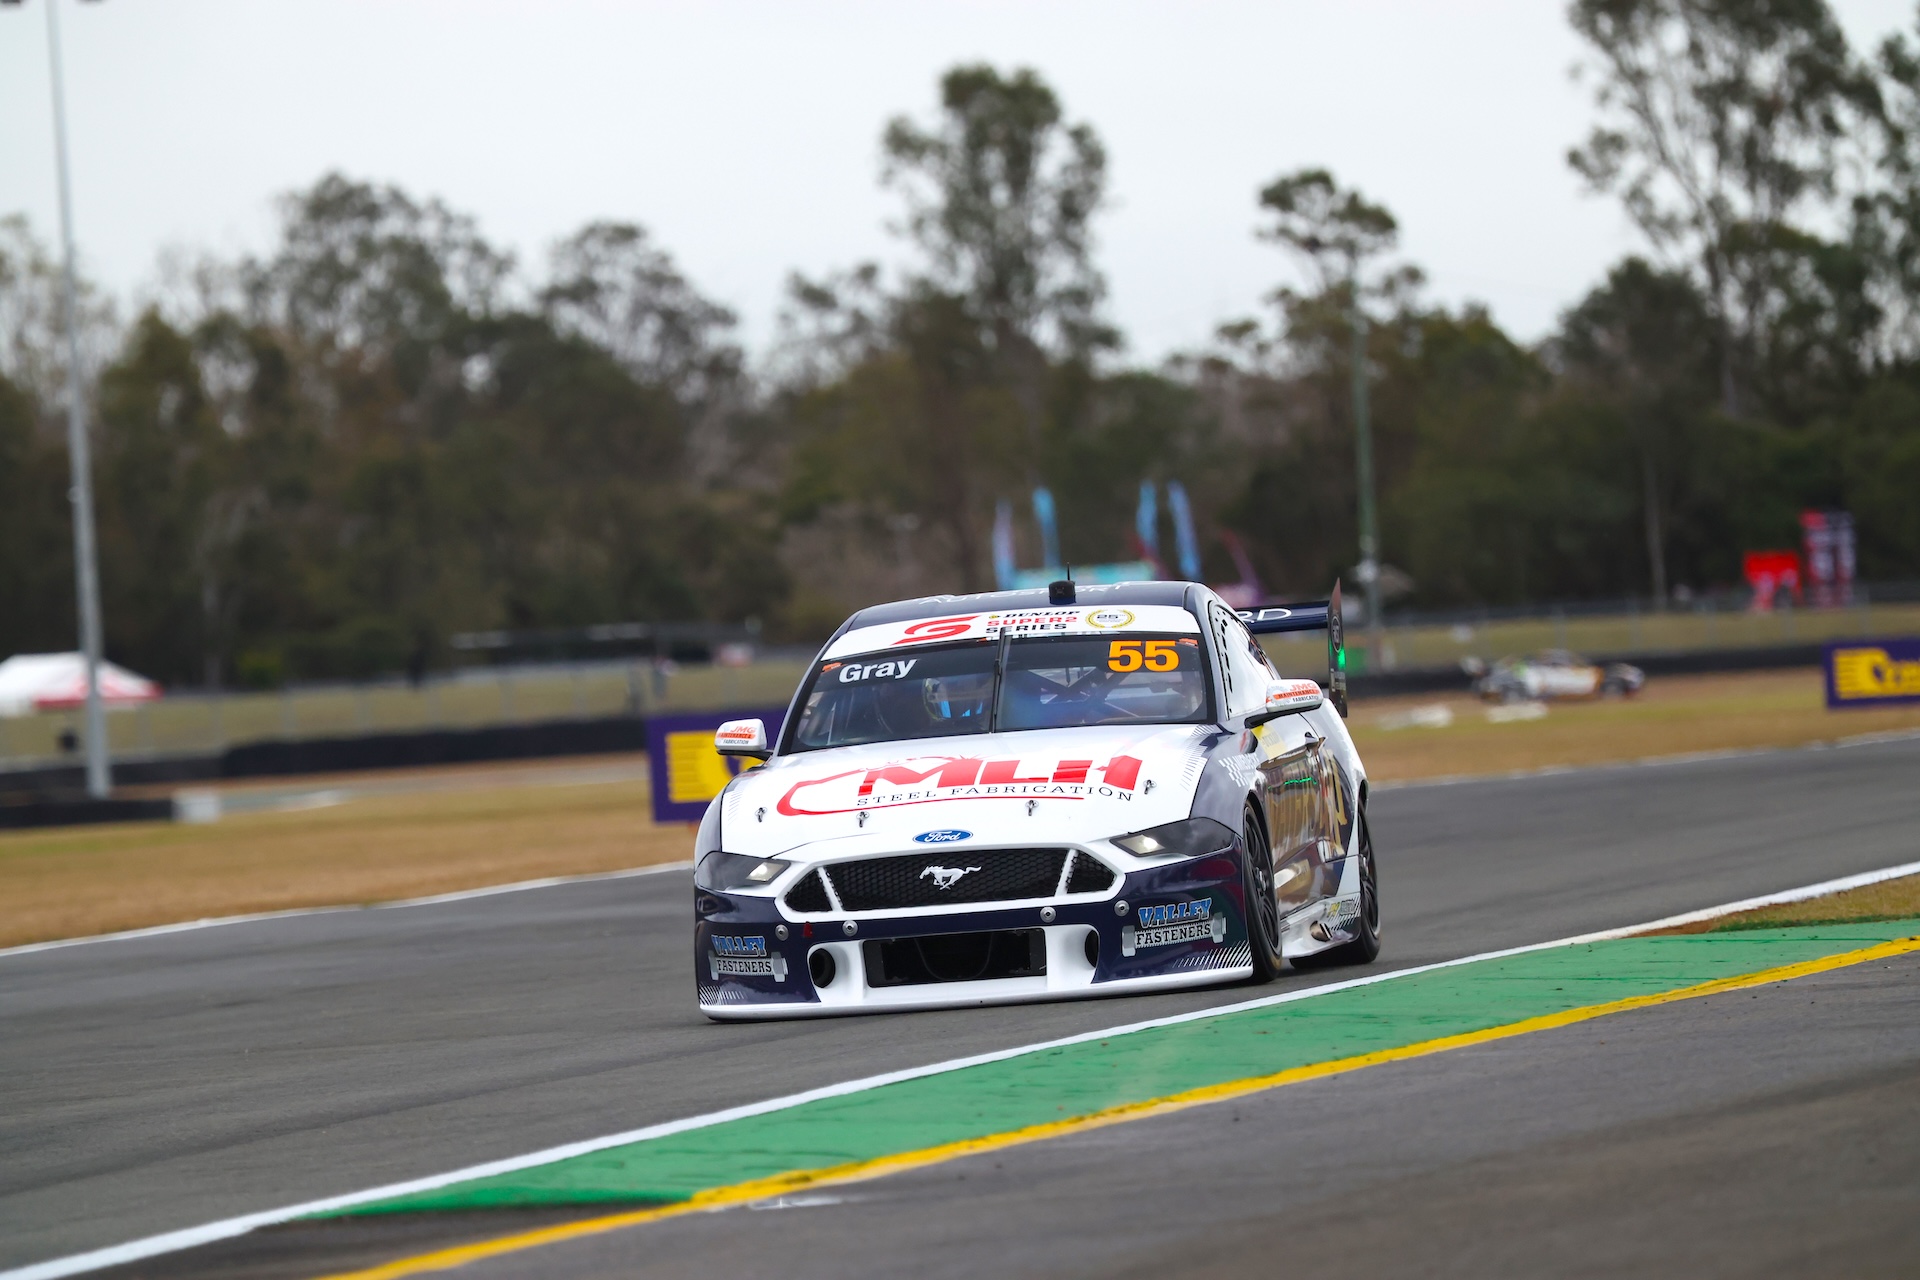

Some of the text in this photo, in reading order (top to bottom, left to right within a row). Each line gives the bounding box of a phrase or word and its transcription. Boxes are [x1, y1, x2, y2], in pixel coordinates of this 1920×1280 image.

[987, 616, 1078, 627] SUPER2
[1003, 611, 1080, 619] DUNLOP
[985, 623, 1067, 634] SERIES
[1107, 640, 1180, 672] 55
[839, 659, 918, 684] Gray
[1290, 683, 1317, 692] JMG
[730, 726, 757, 734] JMG
[857, 785, 1134, 807] STEEL FABRICATION
[924, 830, 962, 843] Ford
[1138, 897, 1212, 928] VALLEY
[1136, 923, 1211, 946] FASTENERS
[711, 934, 767, 957] VALLEY
[717, 959, 772, 973] FASTENERS
